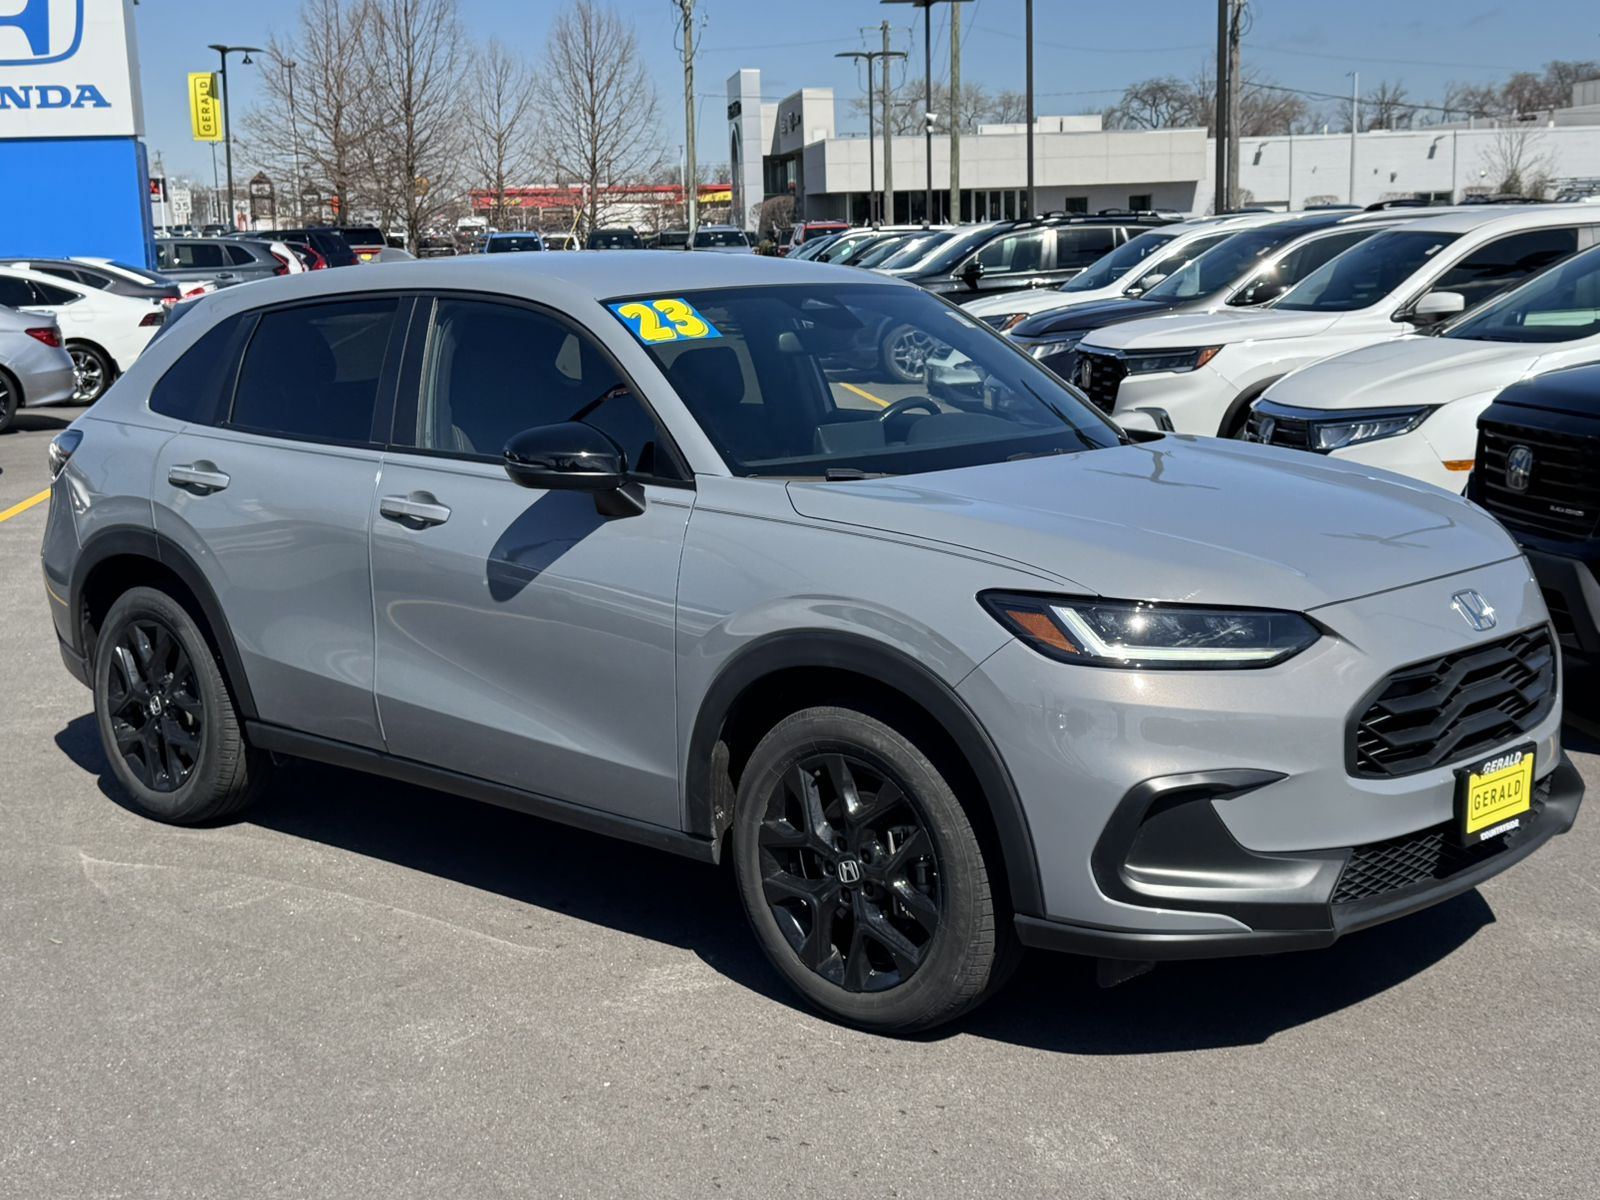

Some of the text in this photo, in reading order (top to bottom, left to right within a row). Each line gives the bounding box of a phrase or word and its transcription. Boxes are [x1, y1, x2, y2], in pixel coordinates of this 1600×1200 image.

[199, 81, 212, 132] GERALD
[175, 202, 190, 211] 35
[618, 299, 710, 342] 23
[1482, 751, 1522, 775] GERALD
[1474, 779, 1521, 811] GERALD
